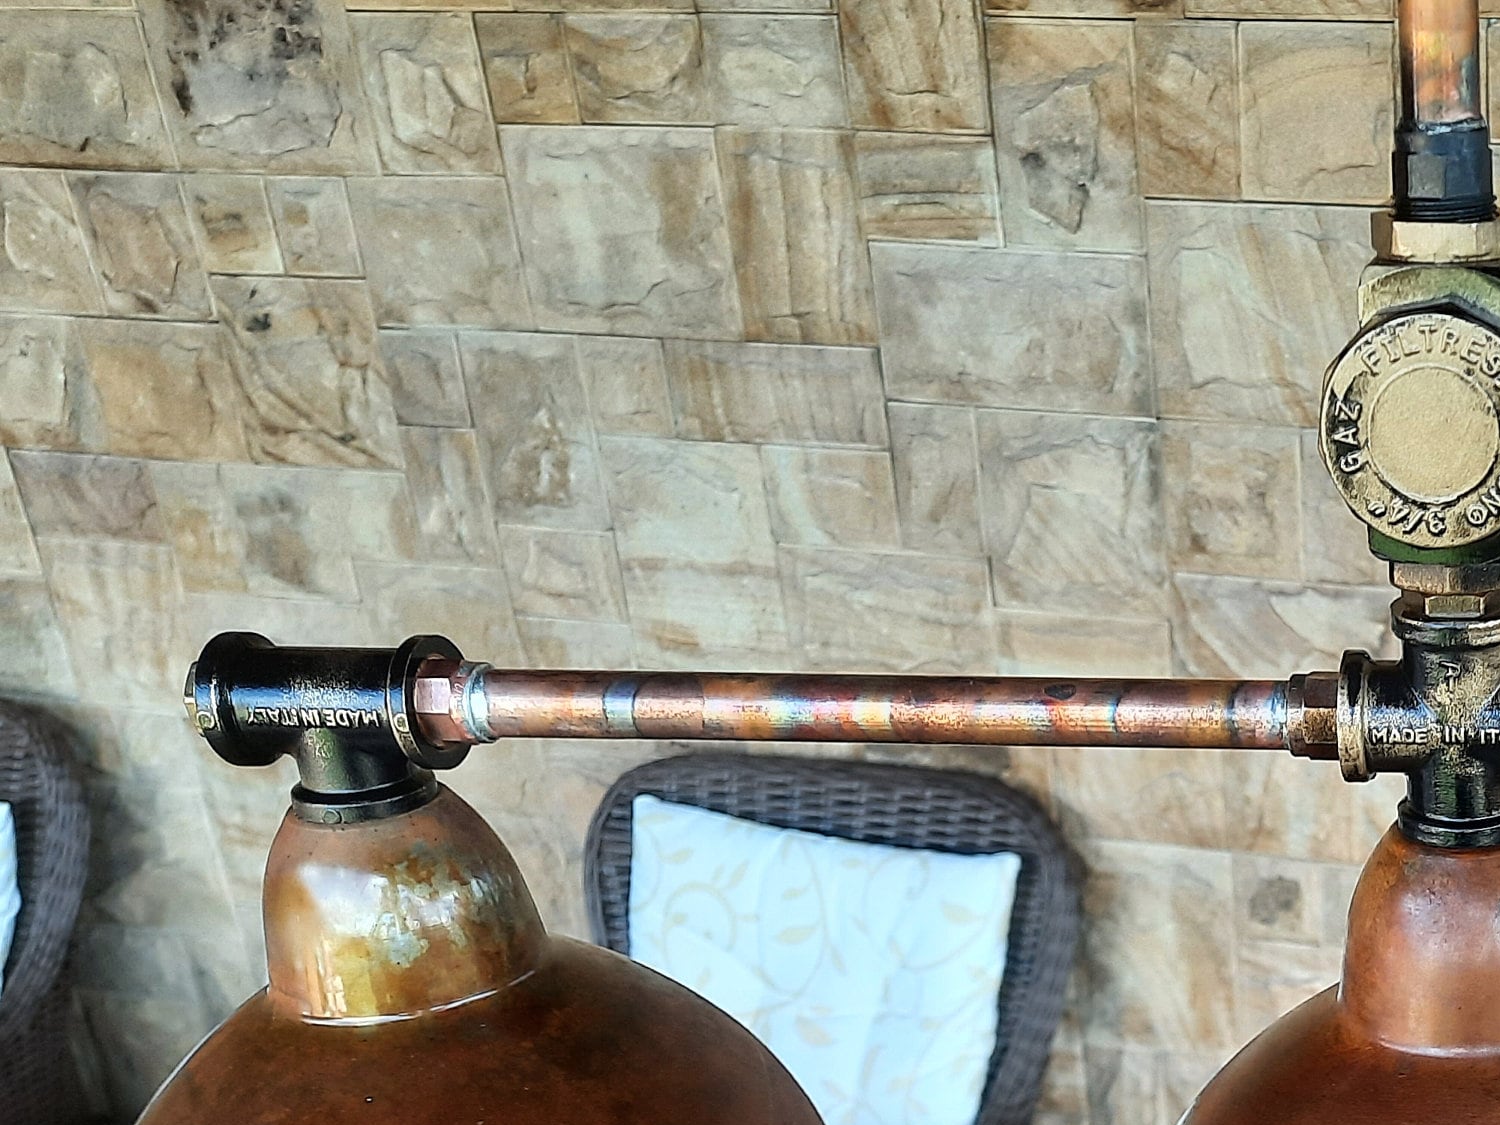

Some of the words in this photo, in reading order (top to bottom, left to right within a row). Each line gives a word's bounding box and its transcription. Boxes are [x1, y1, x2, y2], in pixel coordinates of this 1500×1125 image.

[1334, 399, 1363, 473] GAZ
[248, 706, 299, 728] ITALY
[301, 709, 321, 728] IN
[322, 709, 380, 728] MADE
[1371, 727, 1428, 745] MADE
[1444, 725, 1467, 744] IN
